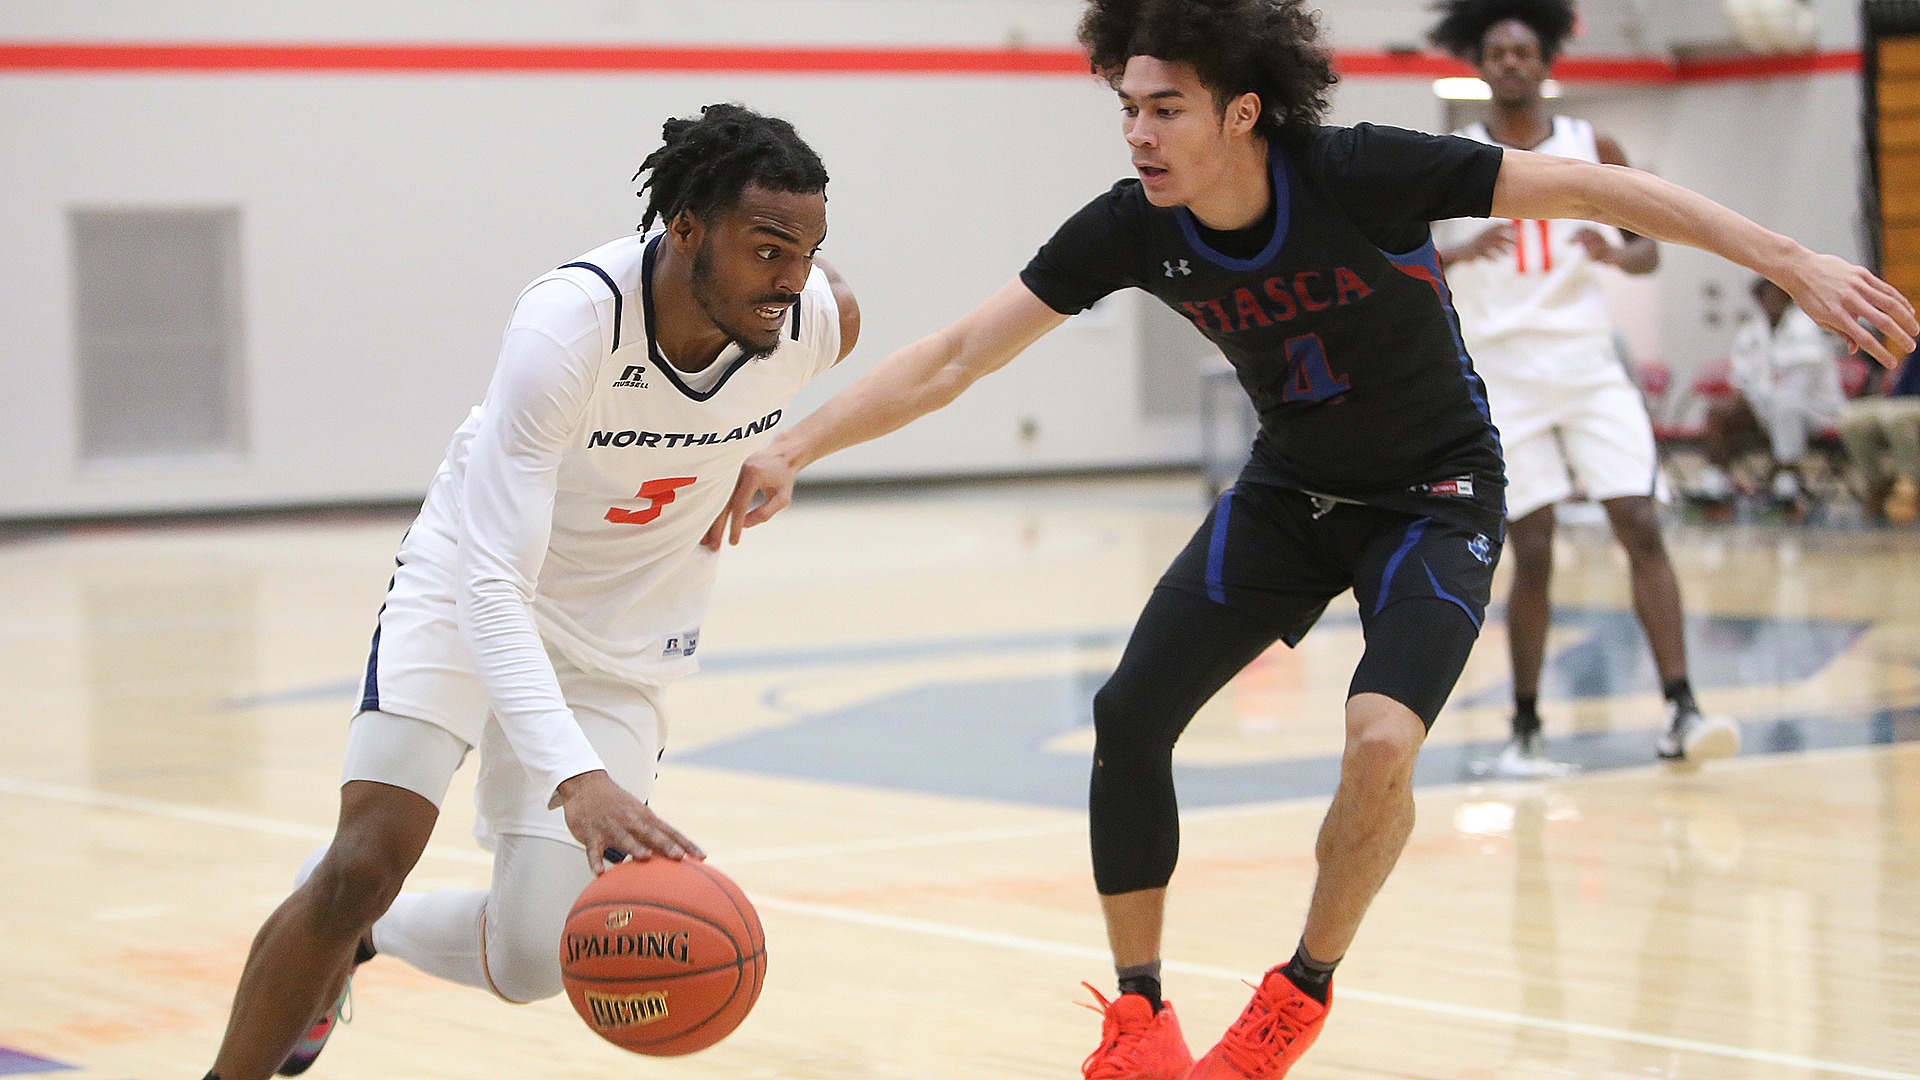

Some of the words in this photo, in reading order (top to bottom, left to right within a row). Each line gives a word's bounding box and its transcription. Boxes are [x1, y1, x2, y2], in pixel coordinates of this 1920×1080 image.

[1511, 219, 1552, 272] 11
[1182, 266, 1373, 332] ITASCA
[612, 381, 649, 389] RUSSELL
[1282, 332, 1351, 404] 4
[587, 408, 783, 449] NORTHLAND
[603, 476, 698, 525] 5
[566, 931, 690, 965] SPALDING
